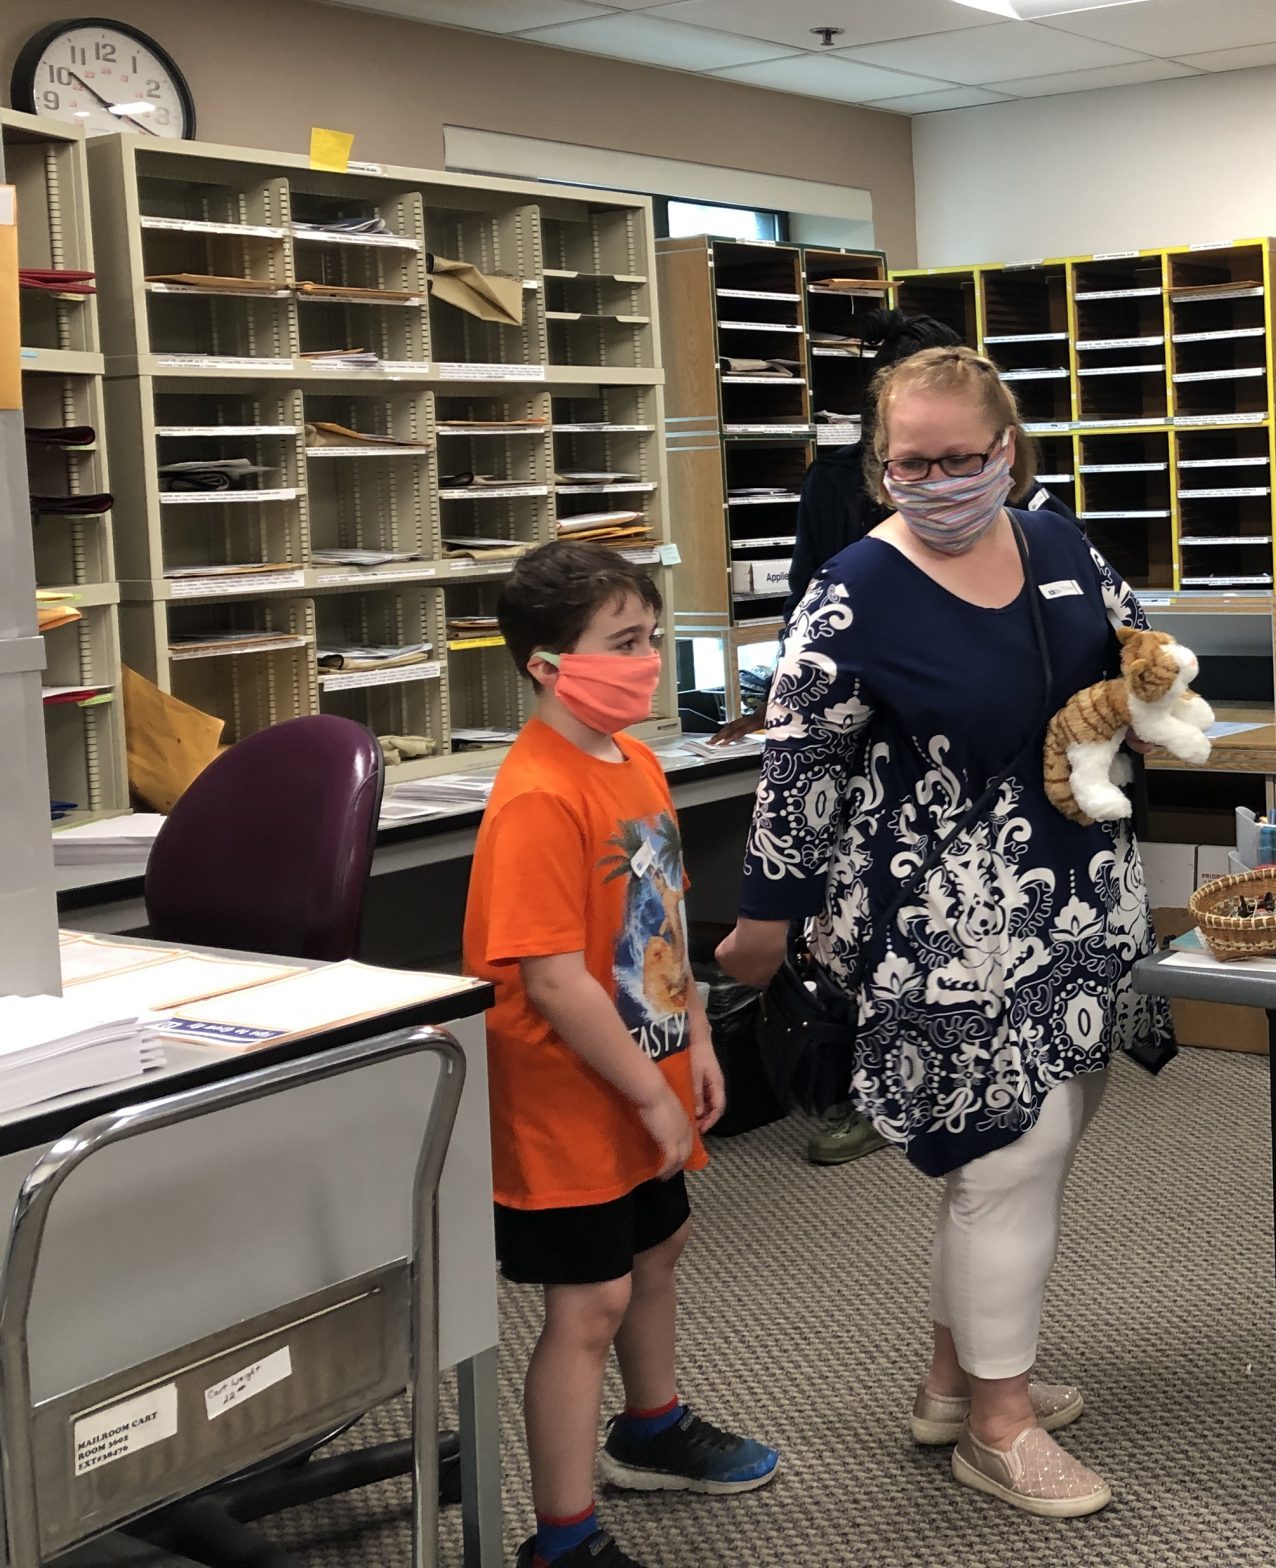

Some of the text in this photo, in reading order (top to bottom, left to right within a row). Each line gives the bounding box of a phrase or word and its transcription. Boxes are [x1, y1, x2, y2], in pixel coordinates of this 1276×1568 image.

[70, 45, 86, 66] 11
[95, 42, 117, 63] 12
[132, 55, 137, 74] 1
[49, 64, 72, 86] 10
[145, 80, 161, 99] 2
[42, 90, 60, 111] 9
[155, 107, 170, 126] 3
[766, 572, 790, 583] Applie
[78, 1411, 158, 1450] MAILROOM CART
[78, 1443, 106, 1460] ROOM
